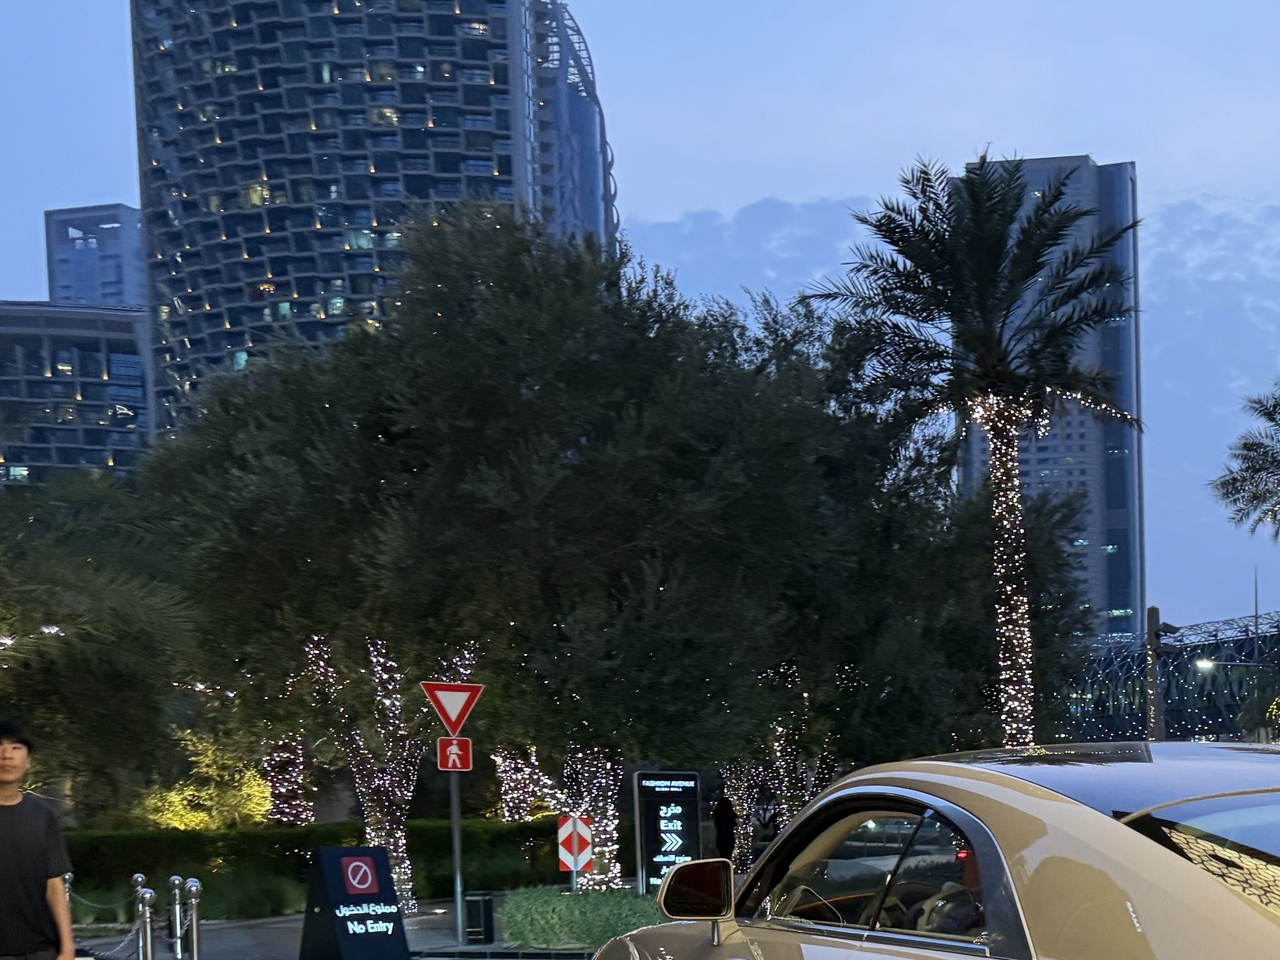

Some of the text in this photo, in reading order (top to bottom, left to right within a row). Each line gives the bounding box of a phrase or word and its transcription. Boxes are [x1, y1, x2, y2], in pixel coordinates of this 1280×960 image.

[659, 803, 682, 817] مخرج
[660, 820, 683, 830] Exit
[335, 902, 398, 917] ممنوع الدخول
[346, 919, 394, 935] No Entry
